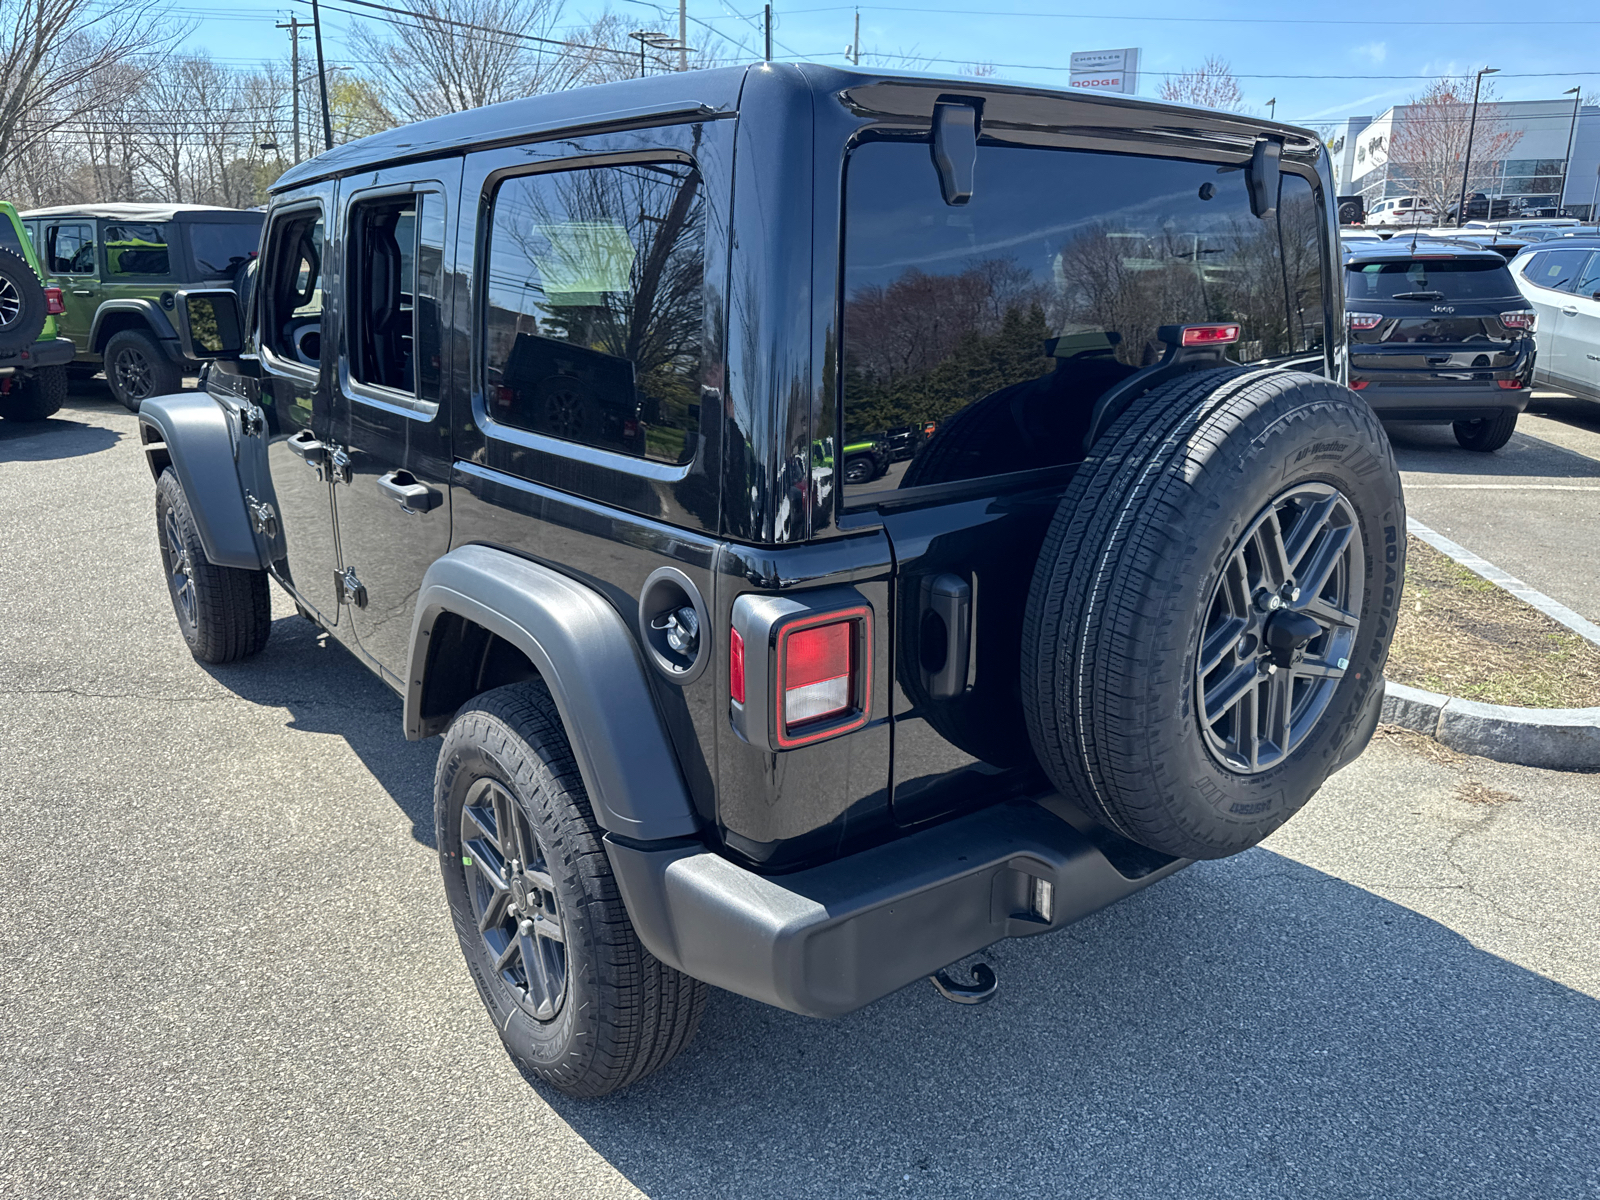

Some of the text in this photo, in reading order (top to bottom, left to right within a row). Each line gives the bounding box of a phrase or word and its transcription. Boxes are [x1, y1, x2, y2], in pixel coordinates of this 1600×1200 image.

[1074, 54, 1121, 62] CHRYSLER
[1072, 78, 1119, 88] DODGE
[1430, 305, 1455, 315] Jeep
[1294, 441, 1348, 464] All-Weather
[1369, 525, 1397, 664] ROADIAN
